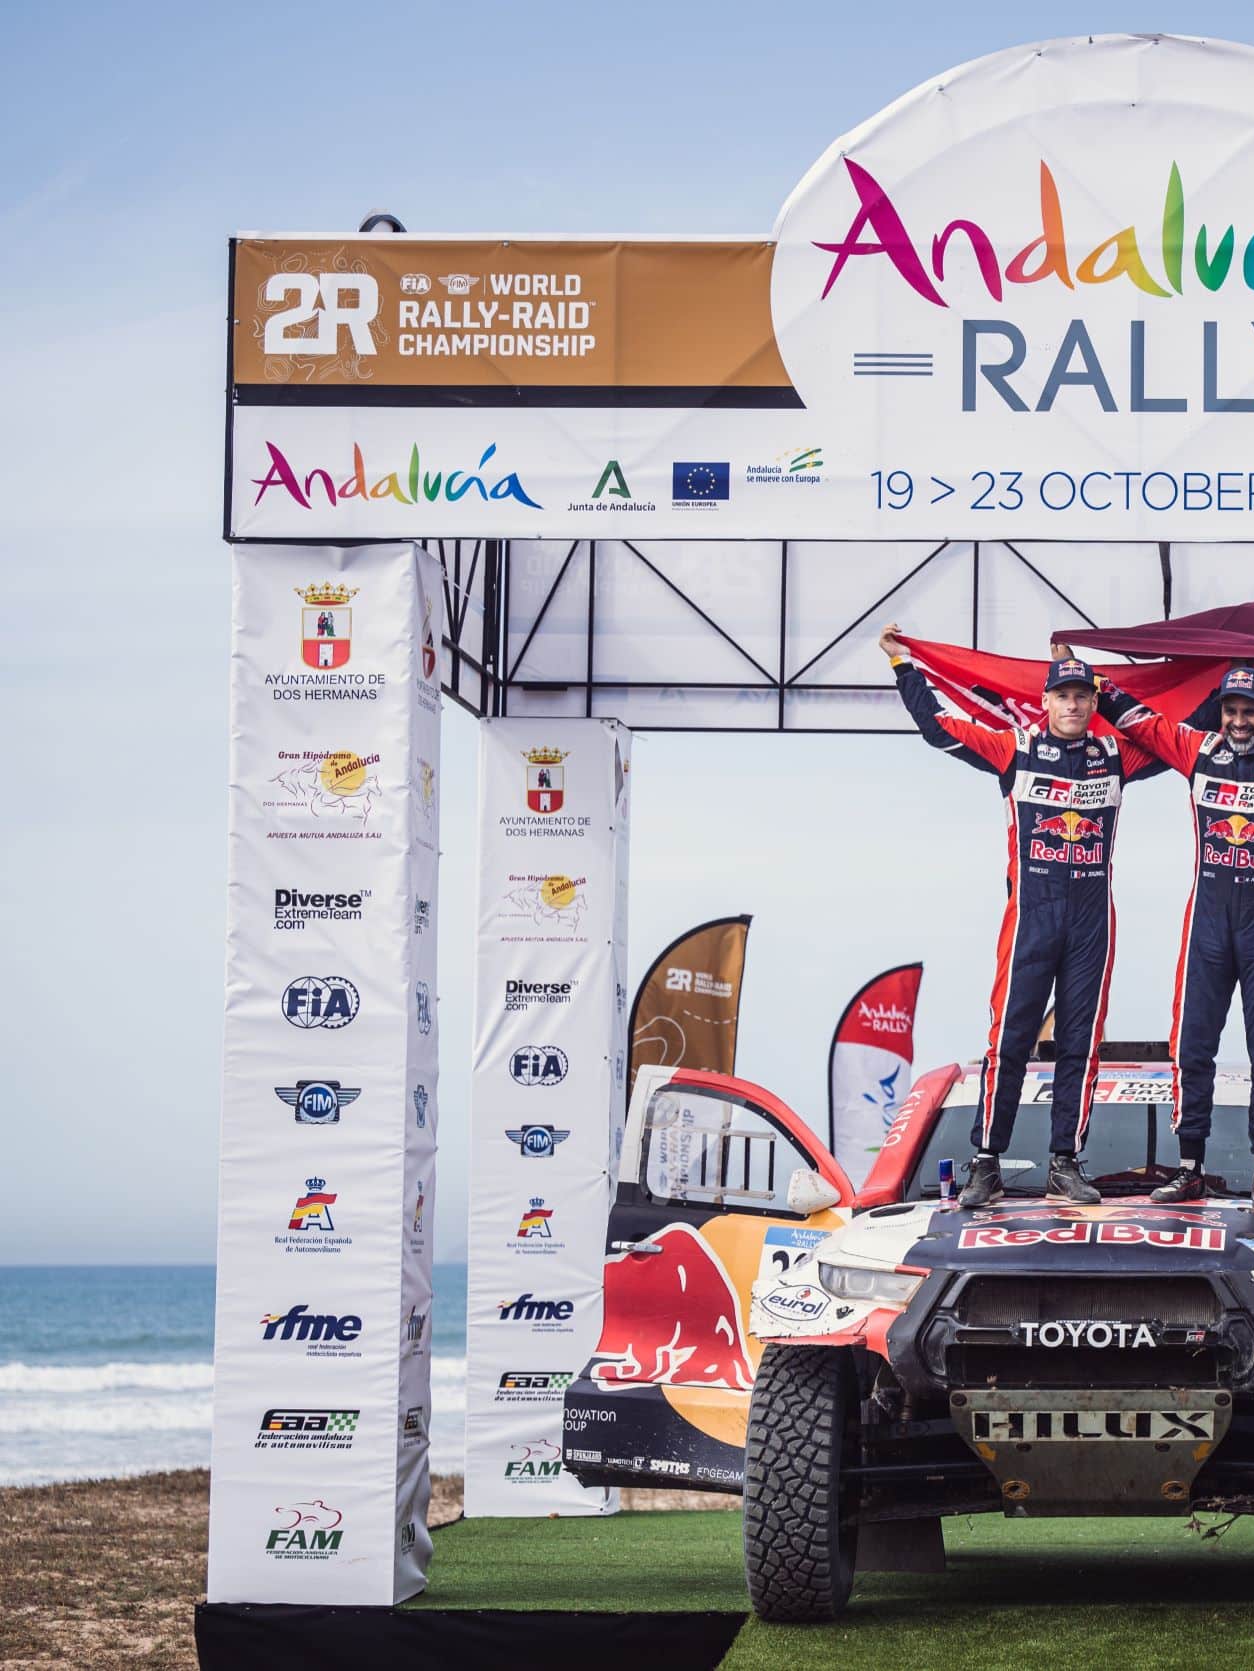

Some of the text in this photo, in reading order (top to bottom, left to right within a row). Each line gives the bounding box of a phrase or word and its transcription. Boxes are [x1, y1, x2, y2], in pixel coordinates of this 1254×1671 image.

[490, 274, 581, 296] WORLD
[264, 273, 377, 355] 2R
[400, 300, 590, 329] RALLY-RAID
[399, 333, 596, 356] CHAMPIONSHIP
[251, 440, 545, 510] Andalucía
[746, 465, 782, 474] Andalucía
[746, 475, 754, 483] se
[795, 474, 821, 484] Europa
[871, 470, 914, 510] 19
[971, 471, 1023, 510] 23
[567, 501, 656, 513] Junta de Andalucía
[264, 674, 385, 685] AYUNTAMIENTO DE
[273, 689, 377, 701] DOS HERMANAS
[278, 751, 352, 762] Gran Hipódromo
[334, 752, 380, 778] Andalucía
[1075, 781, 1111, 791] TOYOTA
[1074, 789, 1108, 798] GAZOO
[1072, 796, 1106, 807] Racing
[500, 817, 591, 826] AYUNTAMIENTO DE
[505, 828, 584, 837] DOS HERMANAS
[1030, 839, 1103, 864] Red Bull
[1204, 842, 1236, 867] Red
[275, 889, 362, 908] Diverse
[274, 907, 362, 920] ExtremeTeam
[273, 919, 305, 930] .com
[506, 980, 571, 994] Diverse
[505, 994, 571, 1003] ExtremeTeam
[504, 1003, 528, 1011] .com
[873, 1020, 909, 1033] RALLY
[304, 1093, 333, 1112] FIM
[527, 1134, 548, 1147] FIM
[274, 1236, 352, 1245] Real Federación Española
[957, 1222, 1226, 1251] Red Bull
[498, 1294, 574, 1320] rfme
[768, 1292, 824, 1315] eurol
[262, 1305, 362, 1341] rfme
[1020, 1322, 1156, 1348] TOYOTA
[974, 1412, 1210, 1439] HILUX
[257, 1432, 353, 1441] federación andaluza
[270, 1441, 352, 1449] automovilismo
[504, 1461, 562, 1476] FAM
[697, 1467, 744, 1481] EDGECAM
[265, 1530, 344, 1550] FAM
